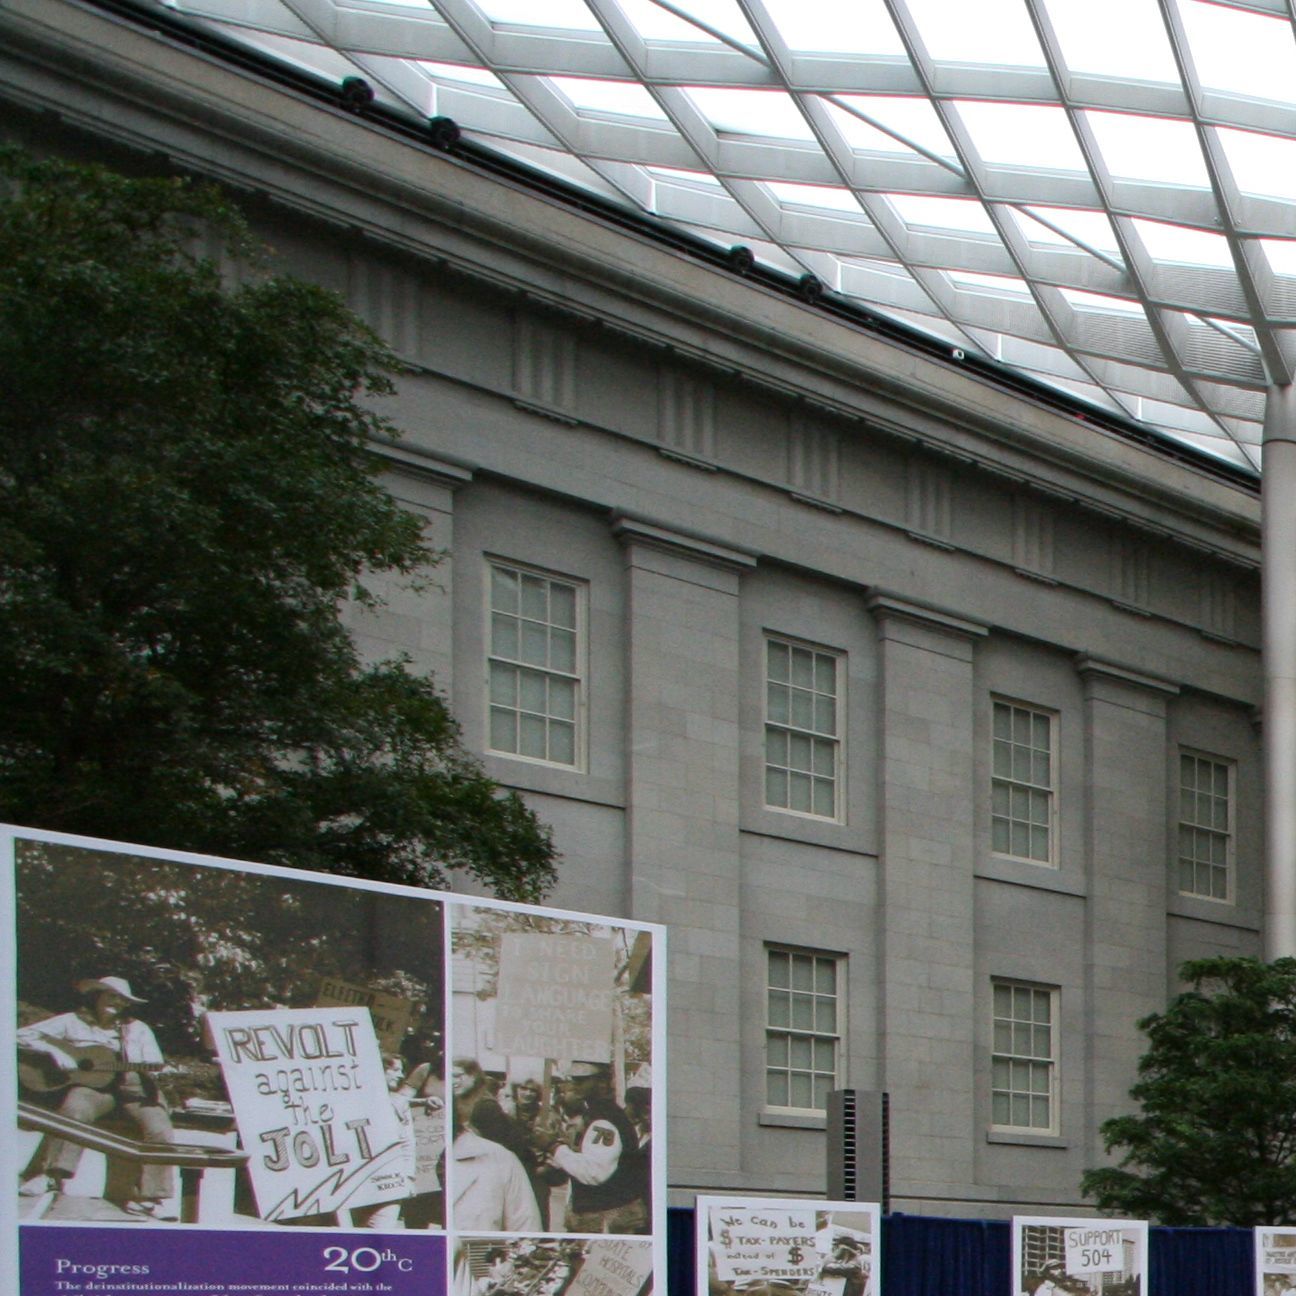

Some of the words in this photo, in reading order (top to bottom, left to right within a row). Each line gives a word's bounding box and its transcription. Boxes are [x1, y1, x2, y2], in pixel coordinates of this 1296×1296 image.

[224, 1020, 359, 1064] REVOLT
[255, 1059, 362, 1104] against
[284, 1096, 335, 1126] the
[260, 1119, 373, 1172] JOLT
[1069, 1229, 1121, 1249] SUPPORT
[55, 1258, 150, 1280] Progress
[1081, 1248, 1112, 1267] 504
[56, 1281, 82, 1291] The
[85, 1281, 225, 1291] deinstitutionalization
[228, 1283, 290, 1292] movement
[293, 1282, 347, 1291] coincided
[350, 1283, 373, 1292] with
[376, 1283, 393, 1292] the
